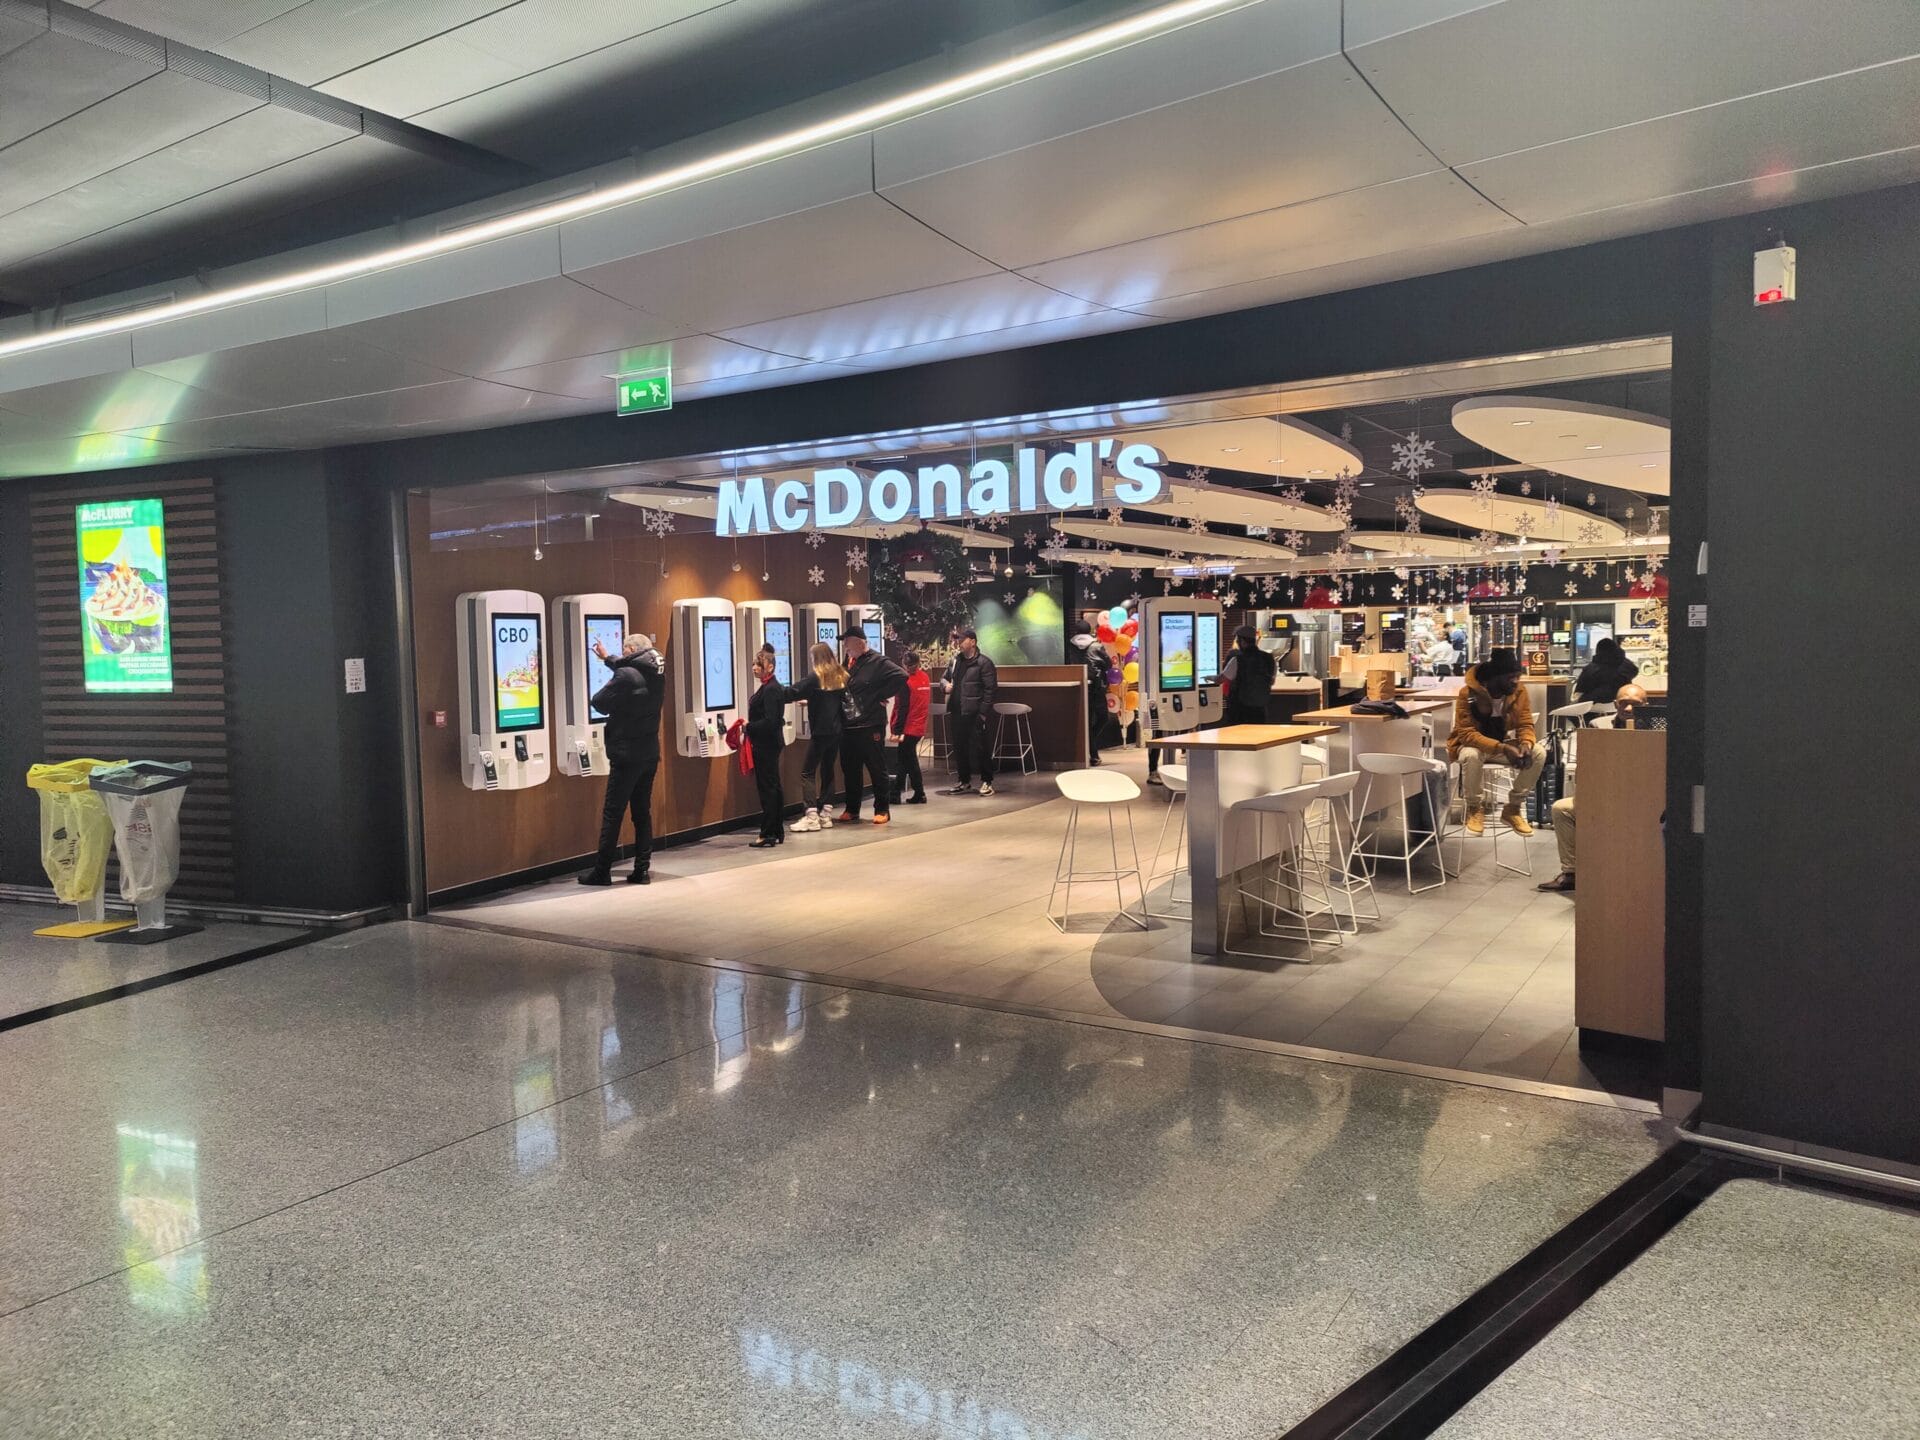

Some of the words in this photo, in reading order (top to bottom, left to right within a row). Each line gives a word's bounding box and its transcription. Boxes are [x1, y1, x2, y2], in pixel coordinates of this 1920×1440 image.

[715, 438, 1162, 537] McDonald's
[498, 627, 528, 643] CBO
[820, 628, 834, 639] CBO
